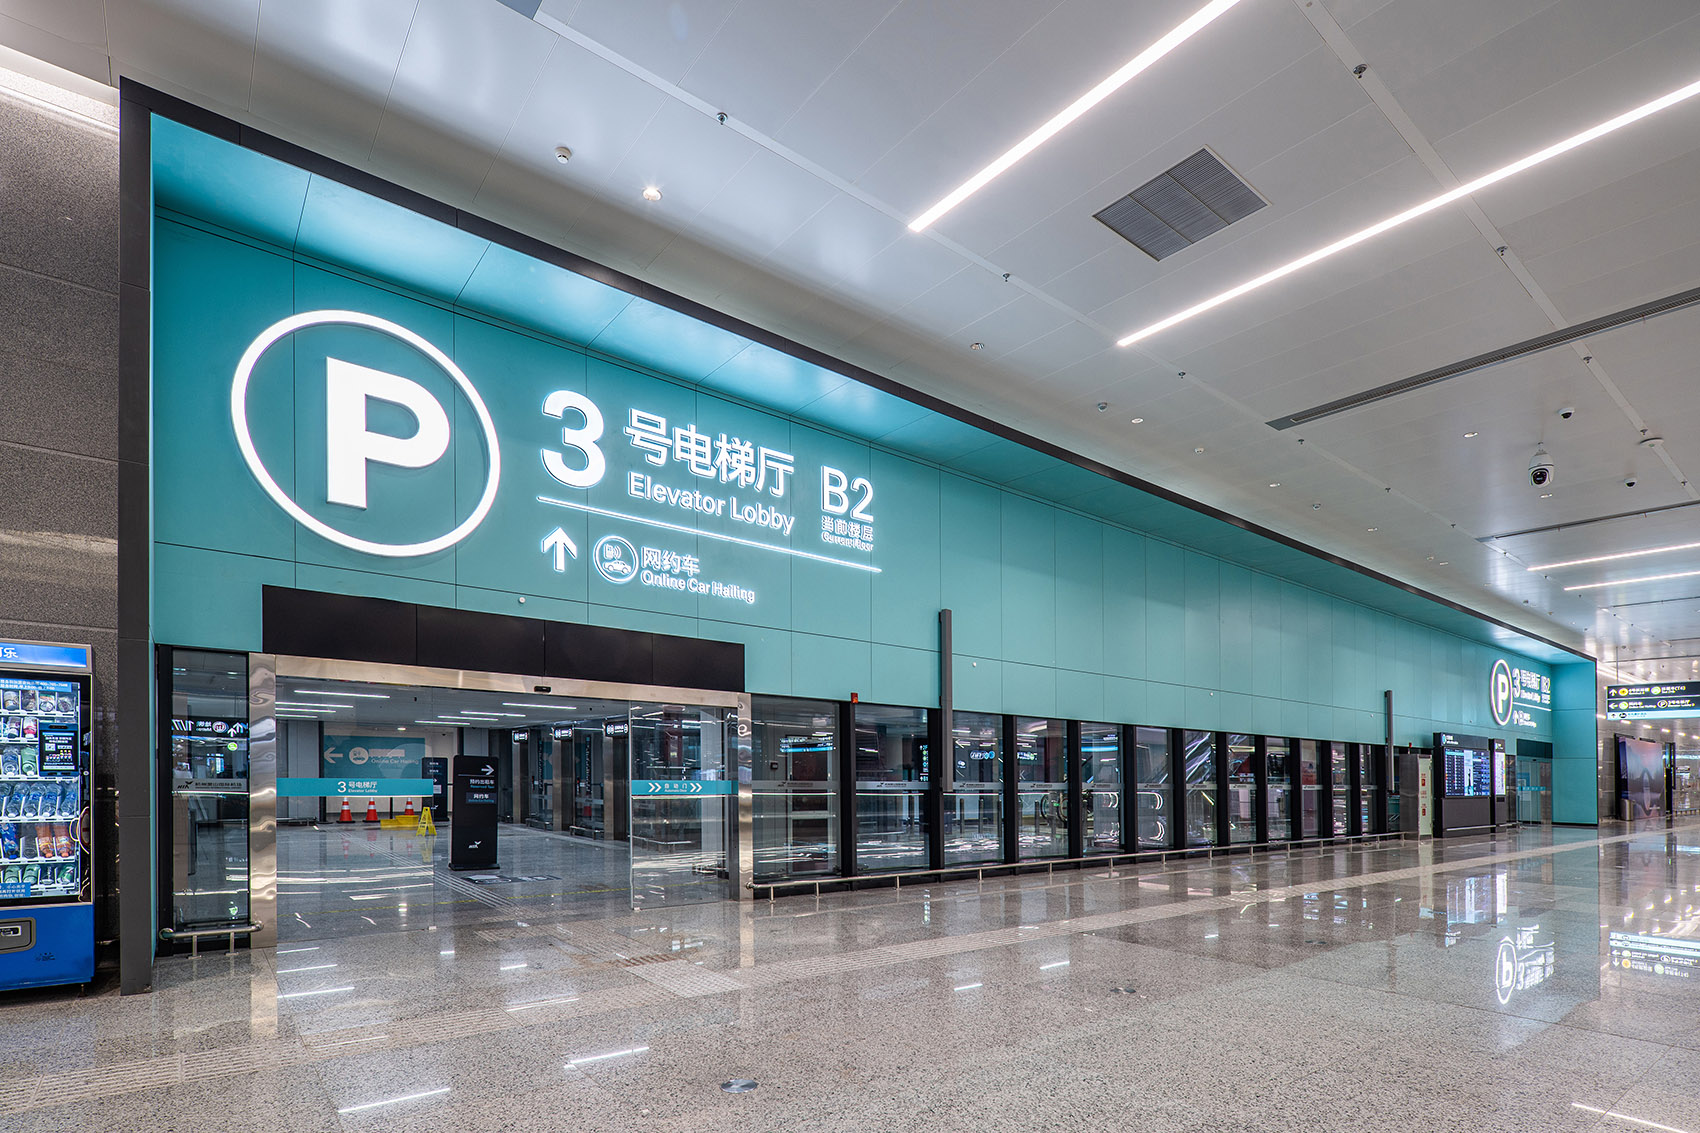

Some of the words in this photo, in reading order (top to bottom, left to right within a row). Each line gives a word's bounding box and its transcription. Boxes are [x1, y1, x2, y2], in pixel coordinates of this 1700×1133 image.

[326, 356, 451, 509] P
[541, 389, 606, 490] 3
[623, 407, 795, 497] 号电梯厅
[628, 471, 726, 516] Elevator
[730, 496, 795, 536] Lobby
[820, 464, 874, 523] B2
[821, 515, 873, 542] 当前楼层
[641, 546, 700, 576] 网约车
[640, 571, 686, 590] Online
[687, 578, 710, 595] Car
[711, 581, 755, 604] Hailing
[0, 647, 18, 659] 乐
[1497, 673, 1509, 714] P
[337, 781, 347, 793] 3
